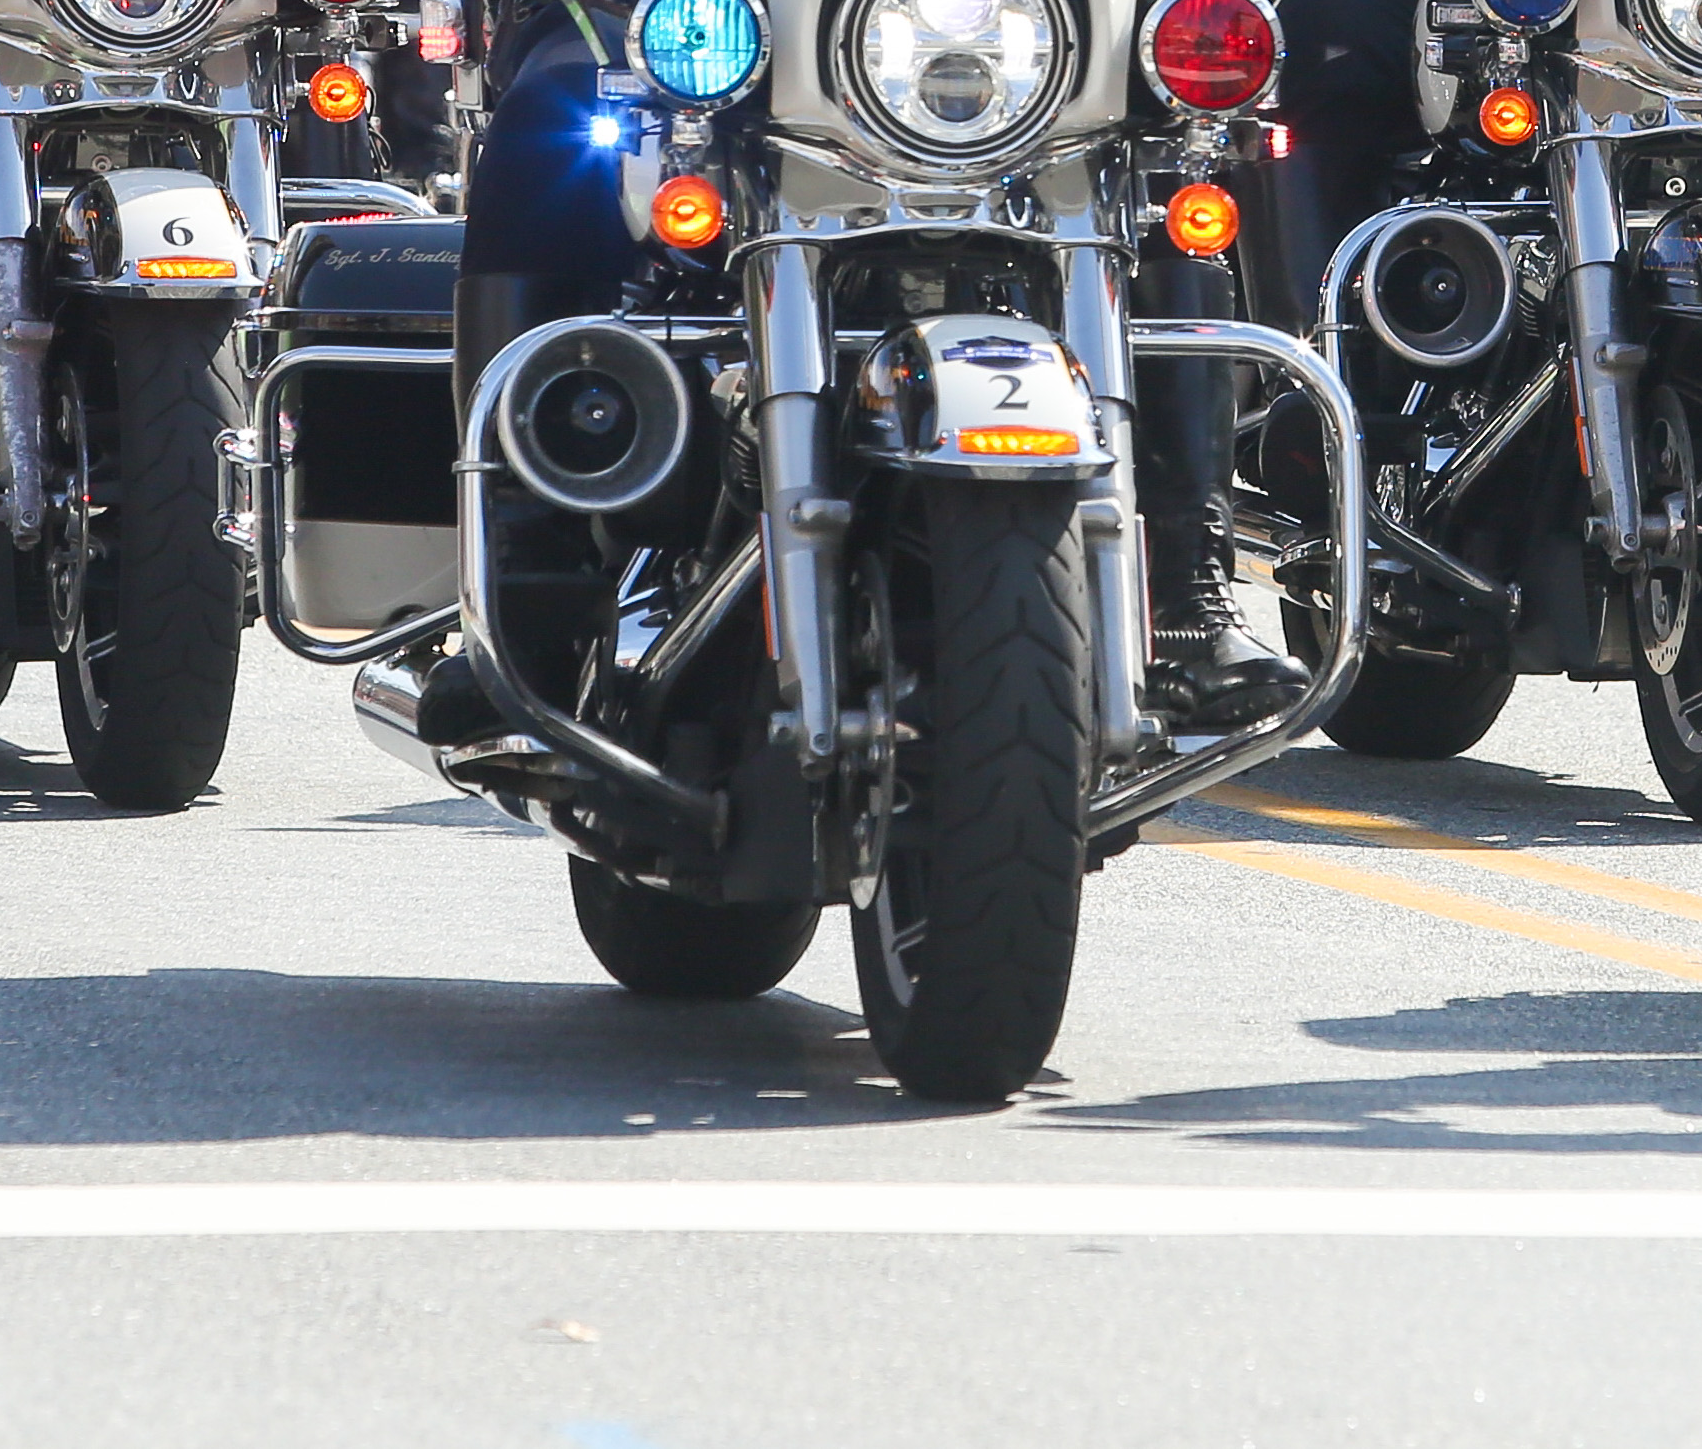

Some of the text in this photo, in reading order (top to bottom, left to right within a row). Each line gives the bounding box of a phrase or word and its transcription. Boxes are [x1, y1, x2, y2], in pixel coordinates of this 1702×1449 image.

[162, 216, 194, 246] 6
[324, 250, 362, 271] Sgt.
[369, 248, 391, 262] J.
[989, 374, 1030, 411] 2
